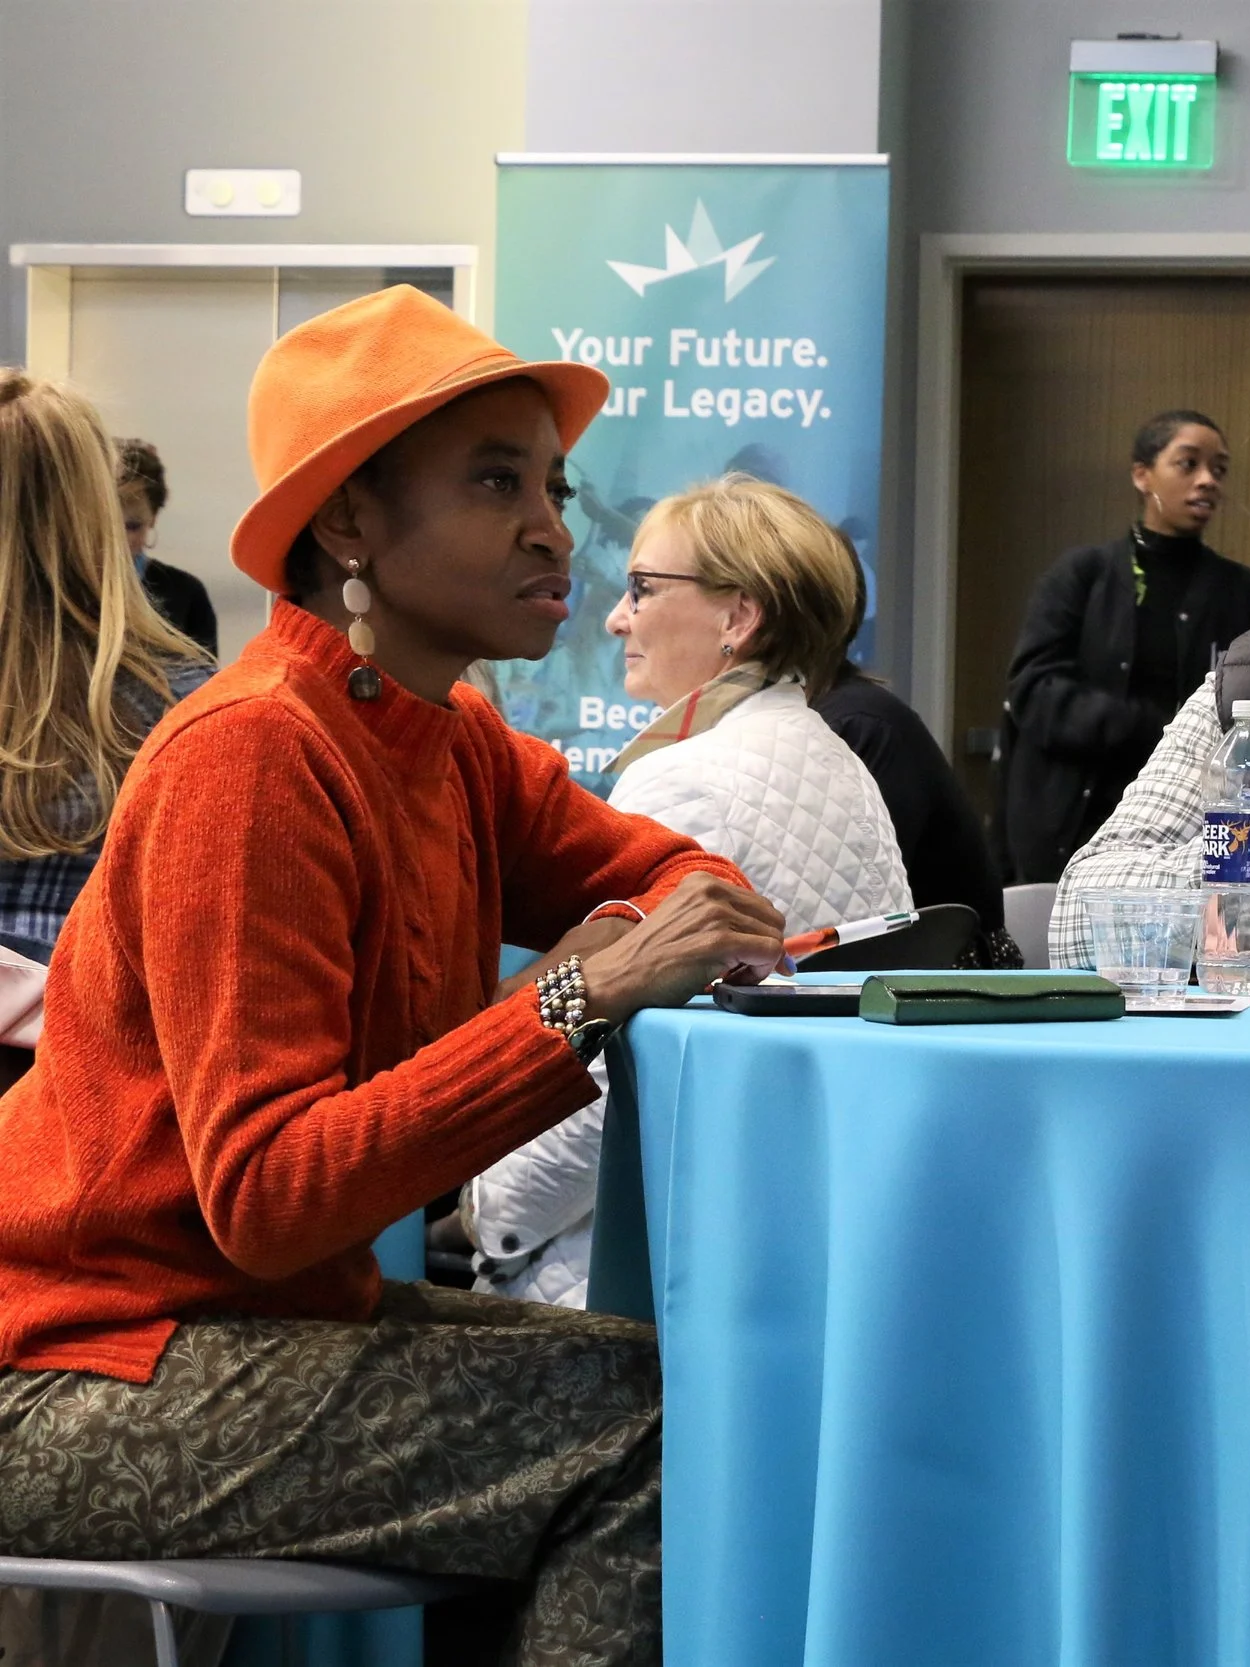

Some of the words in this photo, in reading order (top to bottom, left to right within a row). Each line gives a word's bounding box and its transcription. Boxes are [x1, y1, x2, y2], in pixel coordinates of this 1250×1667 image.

[1097, 82, 1197, 161] EXIT
[551, 327, 653, 366] Your
[669, 328, 829, 368] Future.
[600, 386, 648, 417] ur
[663, 379, 832, 428] Legacy.
[1202, 824, 1230, 840] EER
[1202, 840, 1230, 858] ARK
